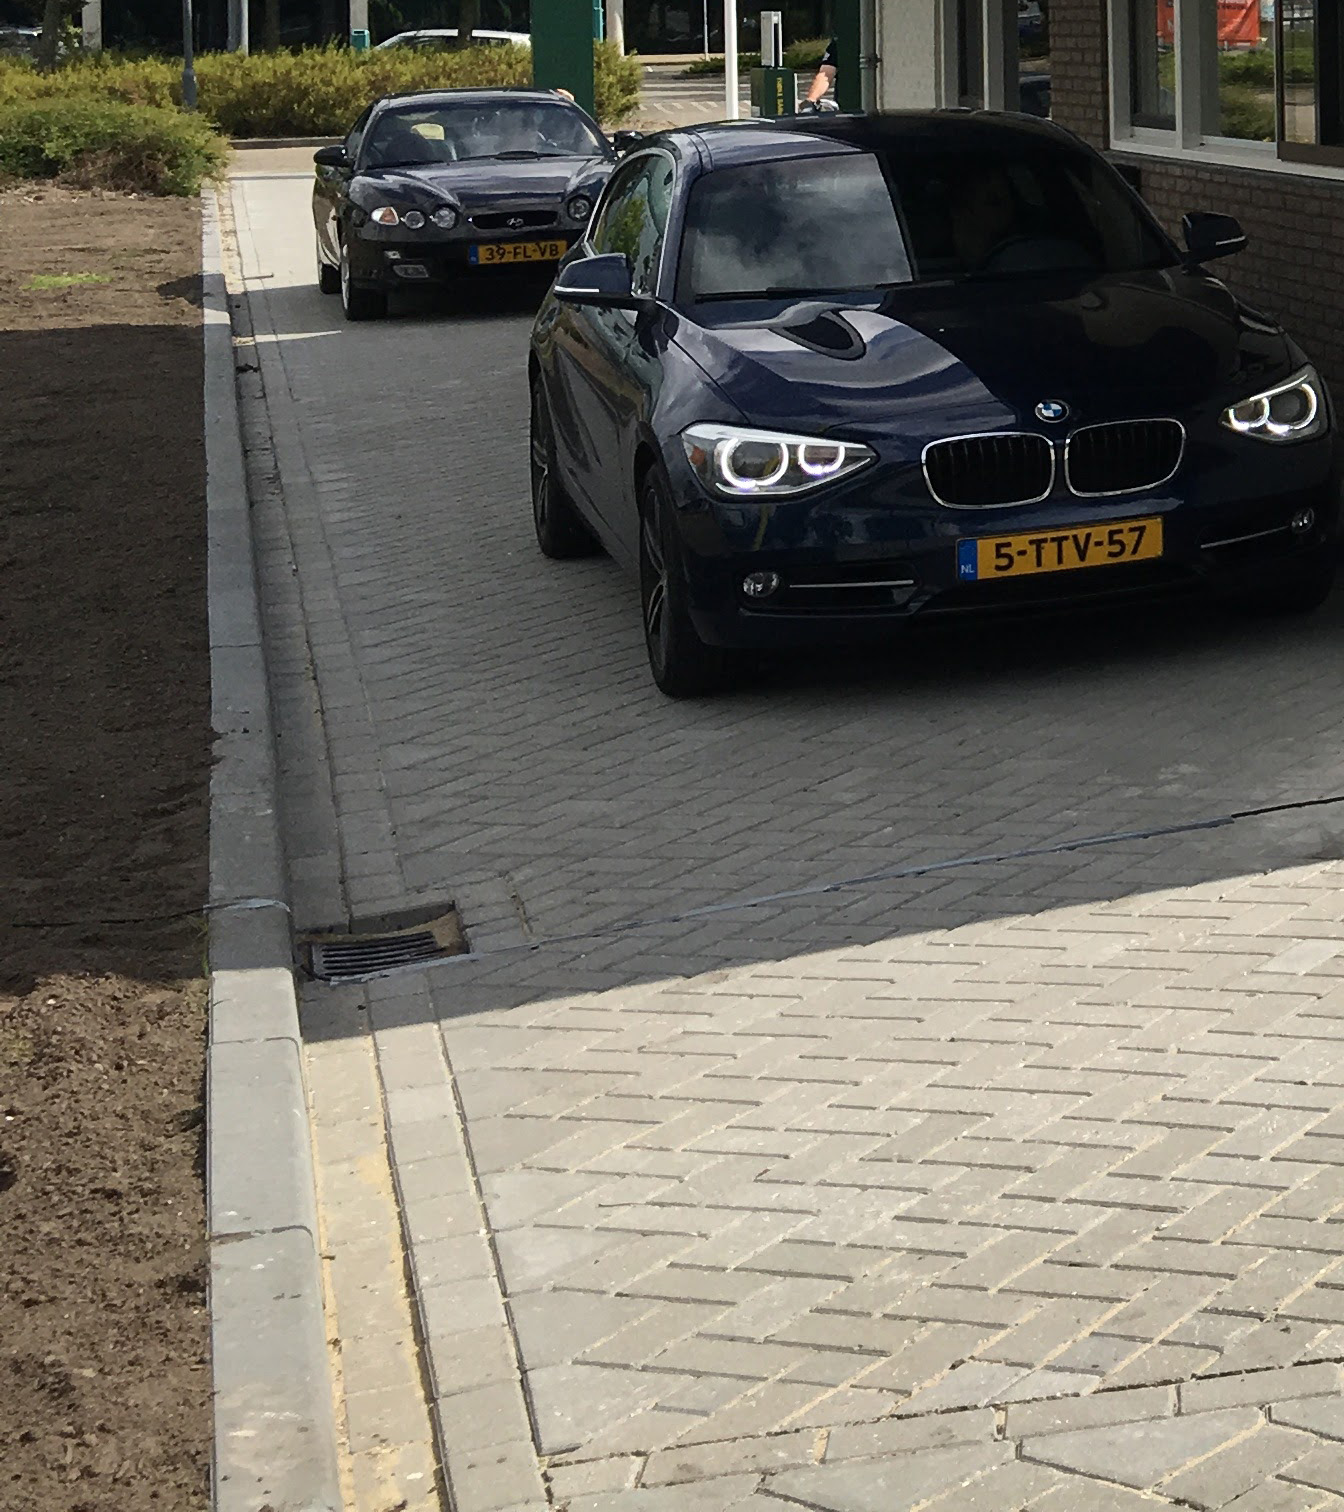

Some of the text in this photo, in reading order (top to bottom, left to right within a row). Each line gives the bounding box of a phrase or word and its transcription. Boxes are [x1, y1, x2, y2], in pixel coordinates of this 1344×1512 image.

[485, 242, 560, 262] 39-FL-VB
[960, 525, 1147, 574] NL 5-TTV-57
